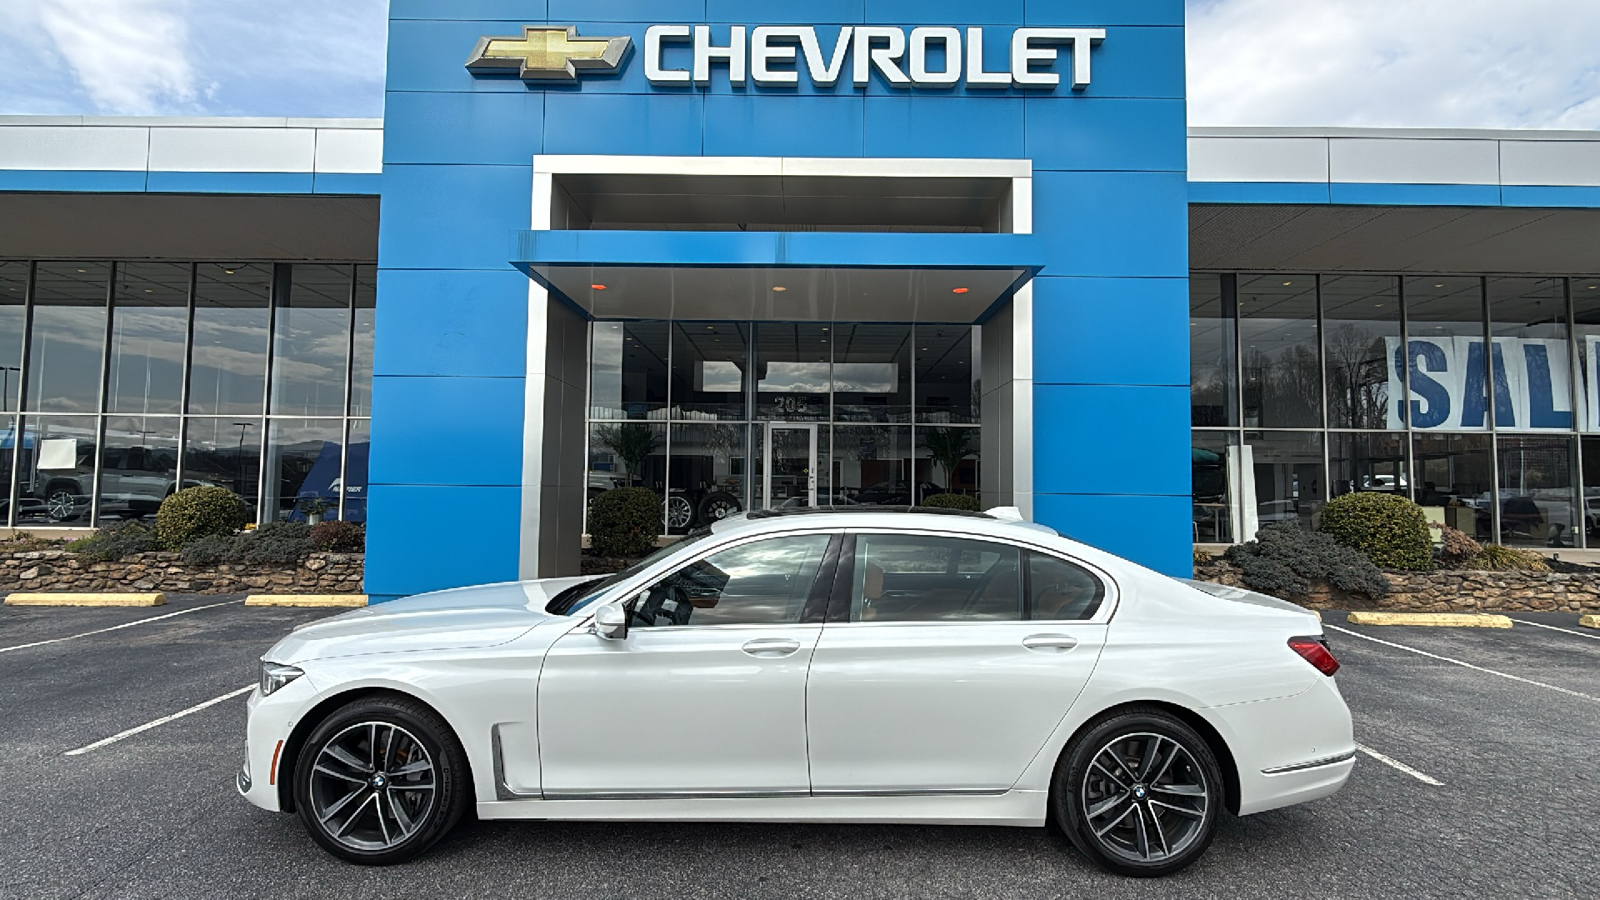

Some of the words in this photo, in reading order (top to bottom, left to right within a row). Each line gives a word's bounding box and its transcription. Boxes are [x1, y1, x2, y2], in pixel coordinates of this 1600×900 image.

[644, 25, 1106, 87] CHEVROLET
[775, 396, 807, 412] 205
[1394, 340, 1600, 428] SAL
